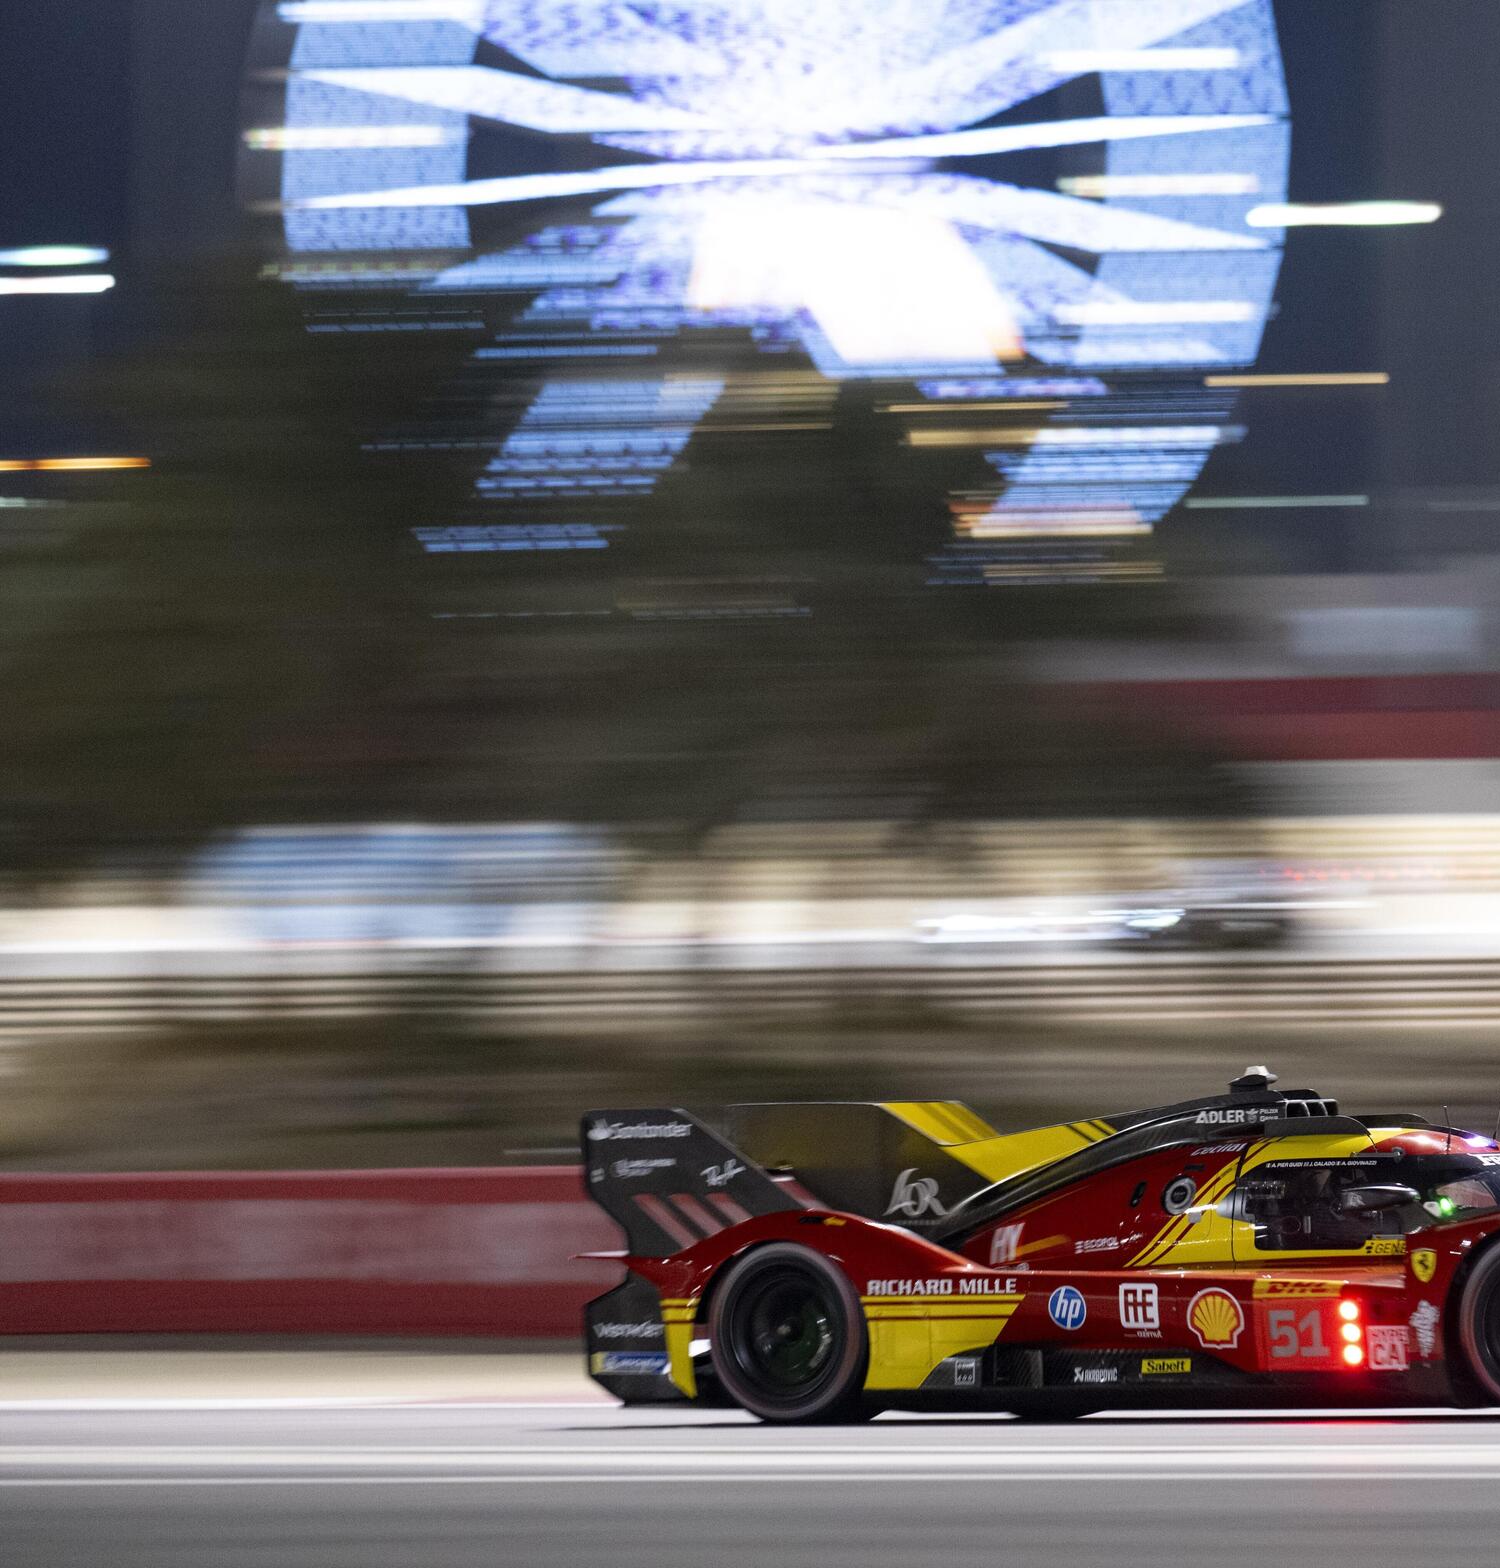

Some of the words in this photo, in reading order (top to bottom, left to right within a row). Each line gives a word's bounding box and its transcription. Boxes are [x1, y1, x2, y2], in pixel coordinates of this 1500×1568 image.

[1195, 1109, 1245, 1124] ADLER
[866, 1279, 953, 1296] RICHARD
[959, 1278, 1017, 1294] MILLE
[1054, 1287, 1082, 1329] hp
[1268, 1309, 1331, 1358] 51
